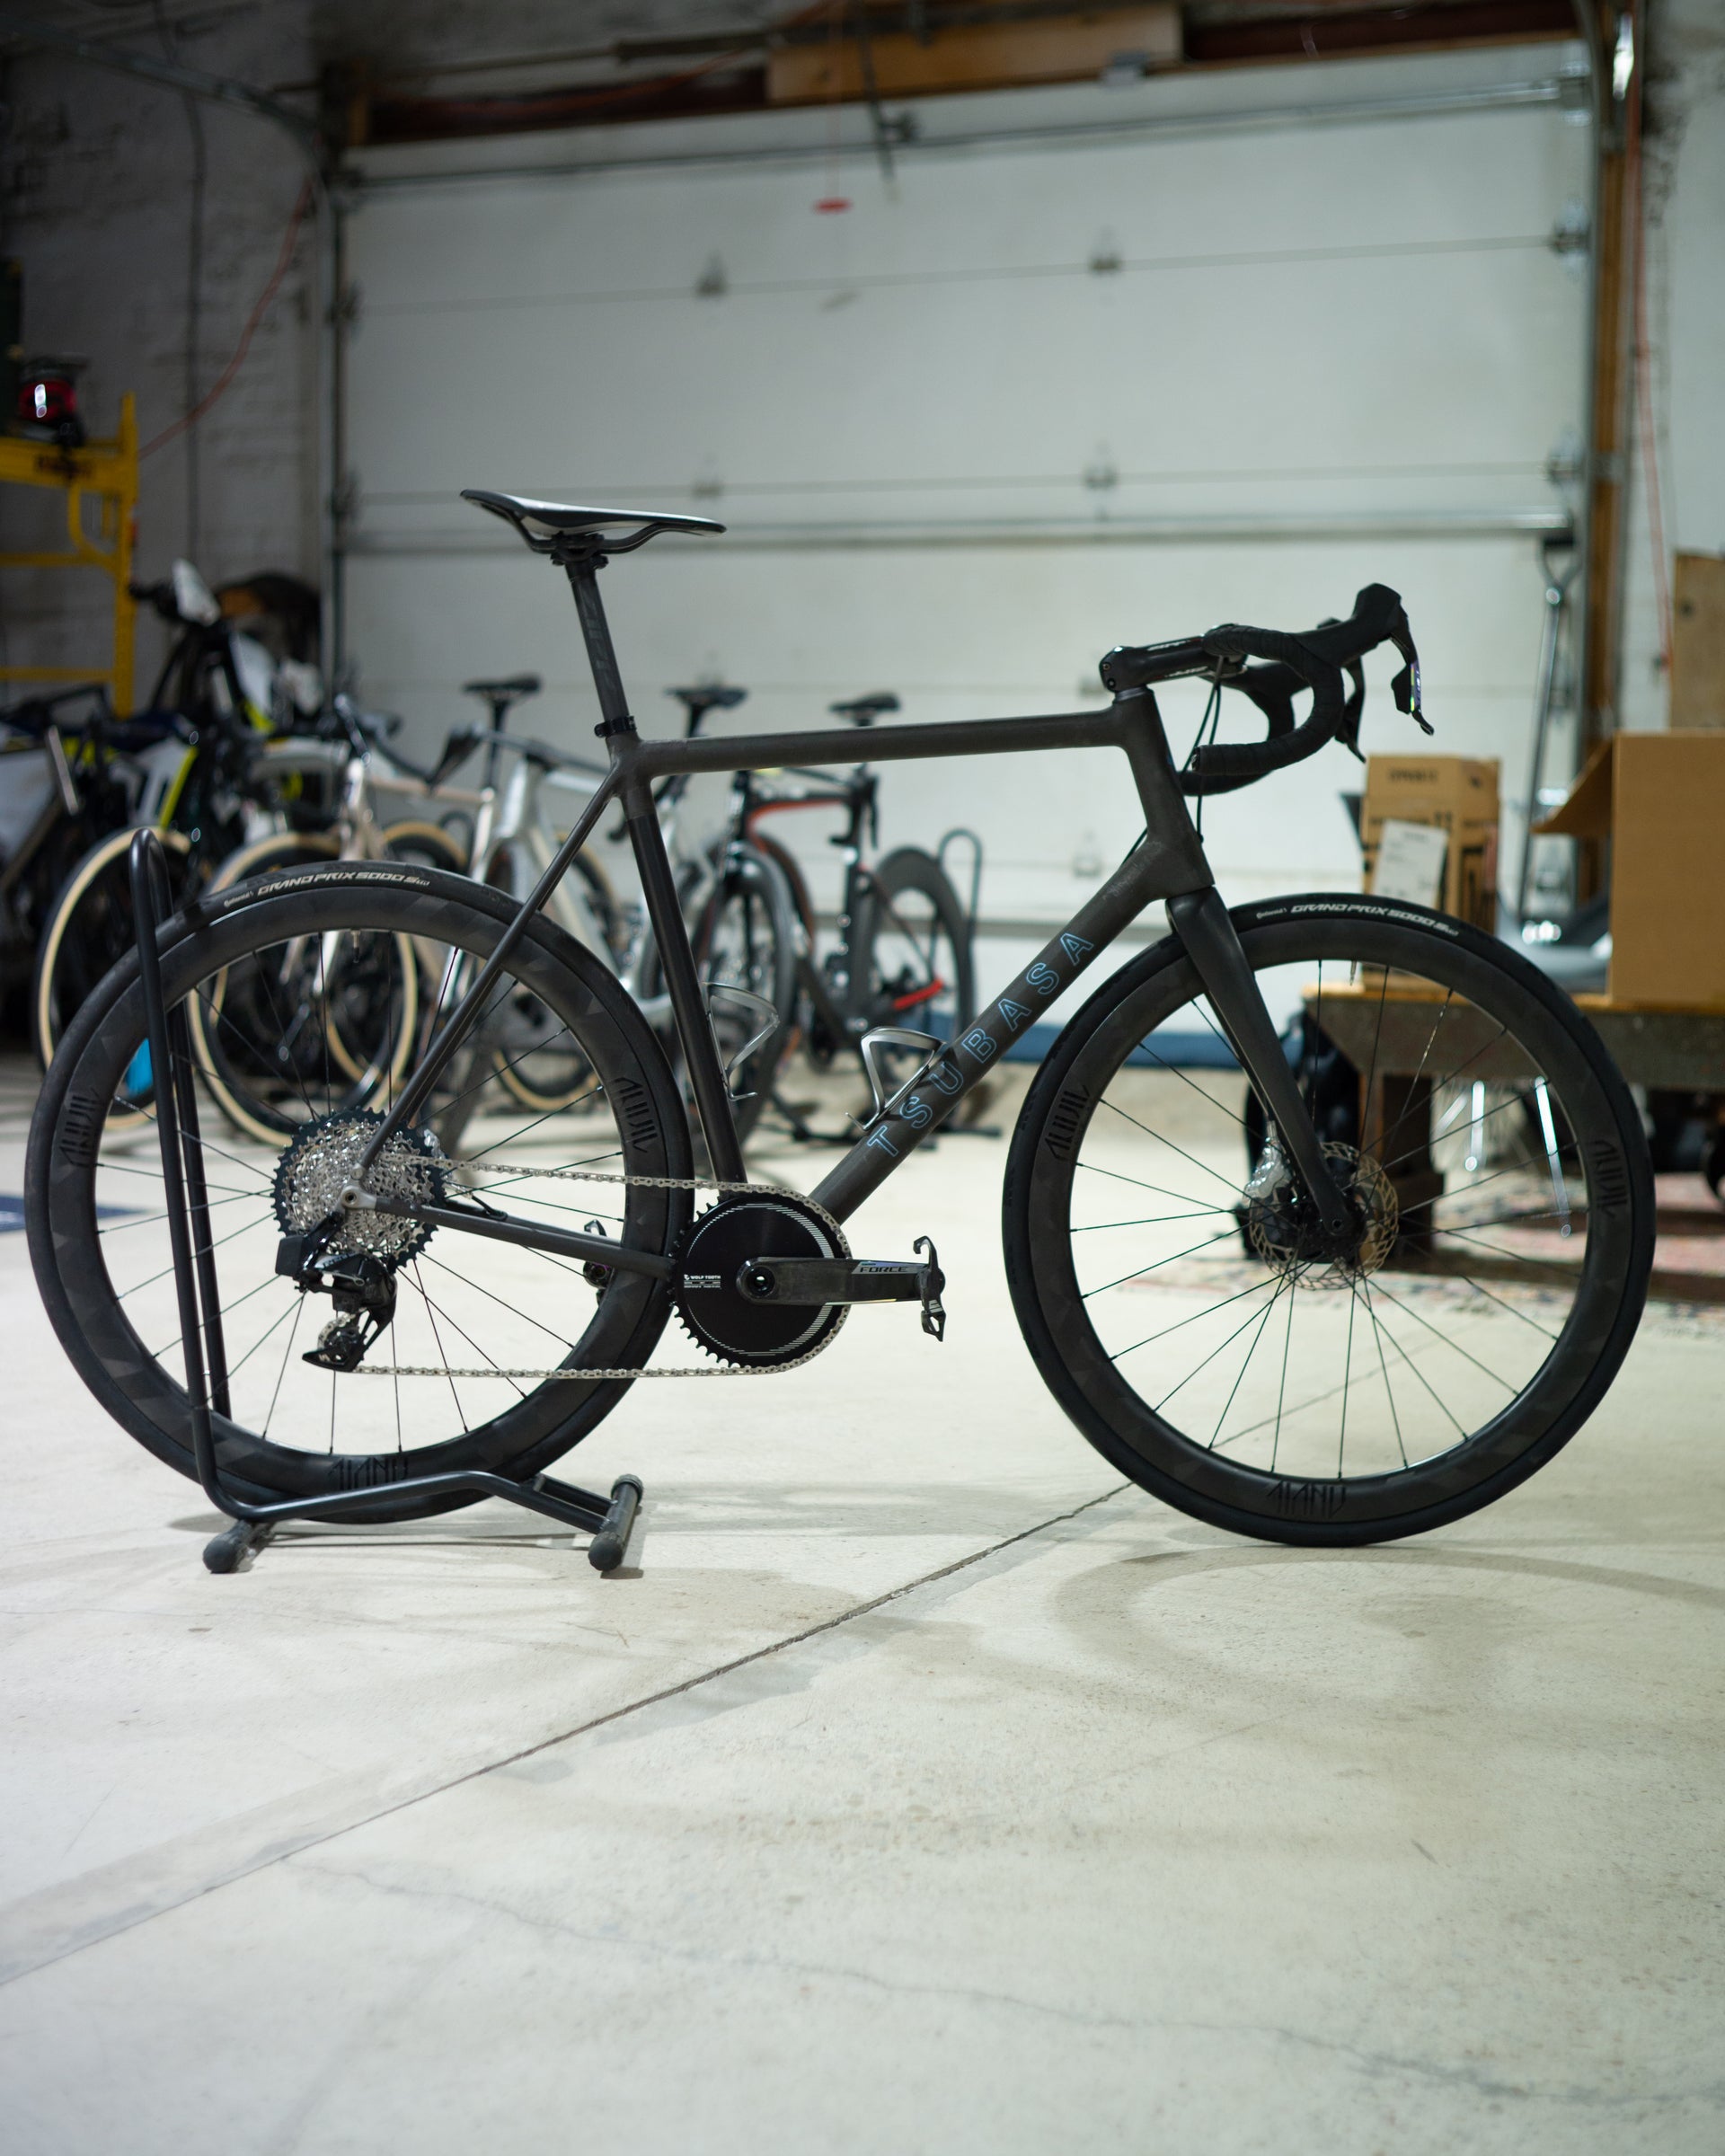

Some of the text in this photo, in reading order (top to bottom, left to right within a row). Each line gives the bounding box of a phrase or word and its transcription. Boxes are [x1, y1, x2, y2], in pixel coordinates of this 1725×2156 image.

[257, 876, 314, 897] GRAND
[314, 871, 356, 883] PRIX
[355, 871, 405, 882] 5000
[1290, 903, 1348, 914] GRAND
[1347, 904, 1389, 915] PRIX
[1387, 909, 1436, 927] 5000
[866, 932, 1093, 1158] TSUBASA
